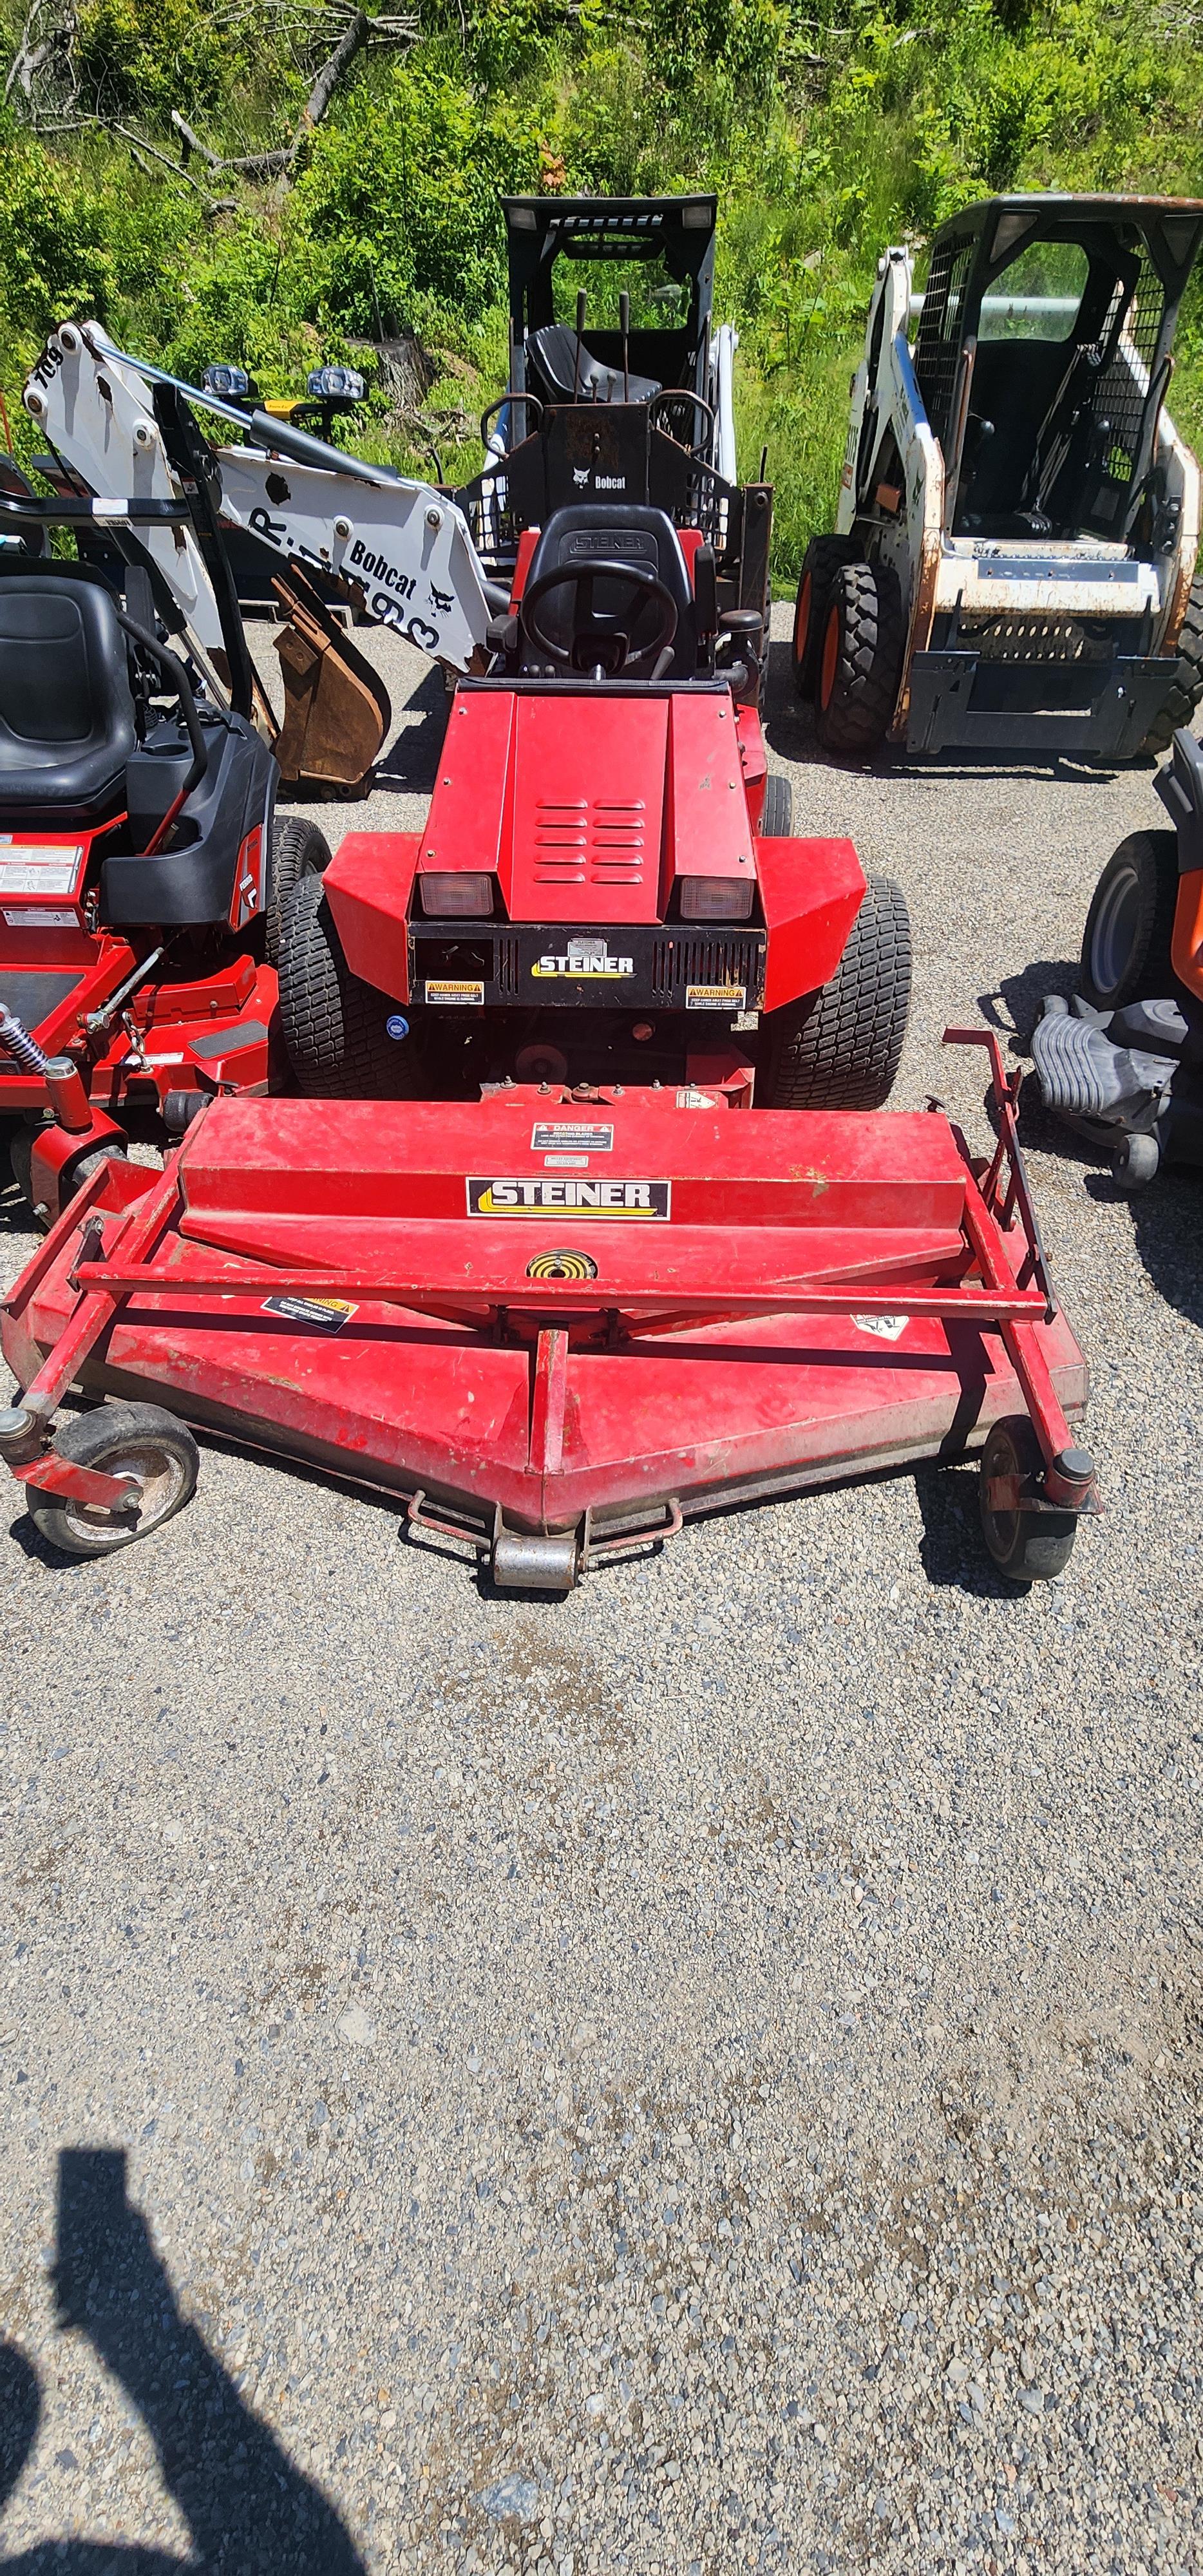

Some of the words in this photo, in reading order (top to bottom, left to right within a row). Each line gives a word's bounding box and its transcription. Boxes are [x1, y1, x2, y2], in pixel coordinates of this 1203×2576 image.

[34, 346, 64, 390] 709
[595, 476, 625, 489] Bobcat
[350, 539, 417, 600] Bobcat
[540, 956, 634, 972] STEINER
[491, 1181, 650, 1207] STEINER
[313, 1298, 338, 1307] NING
